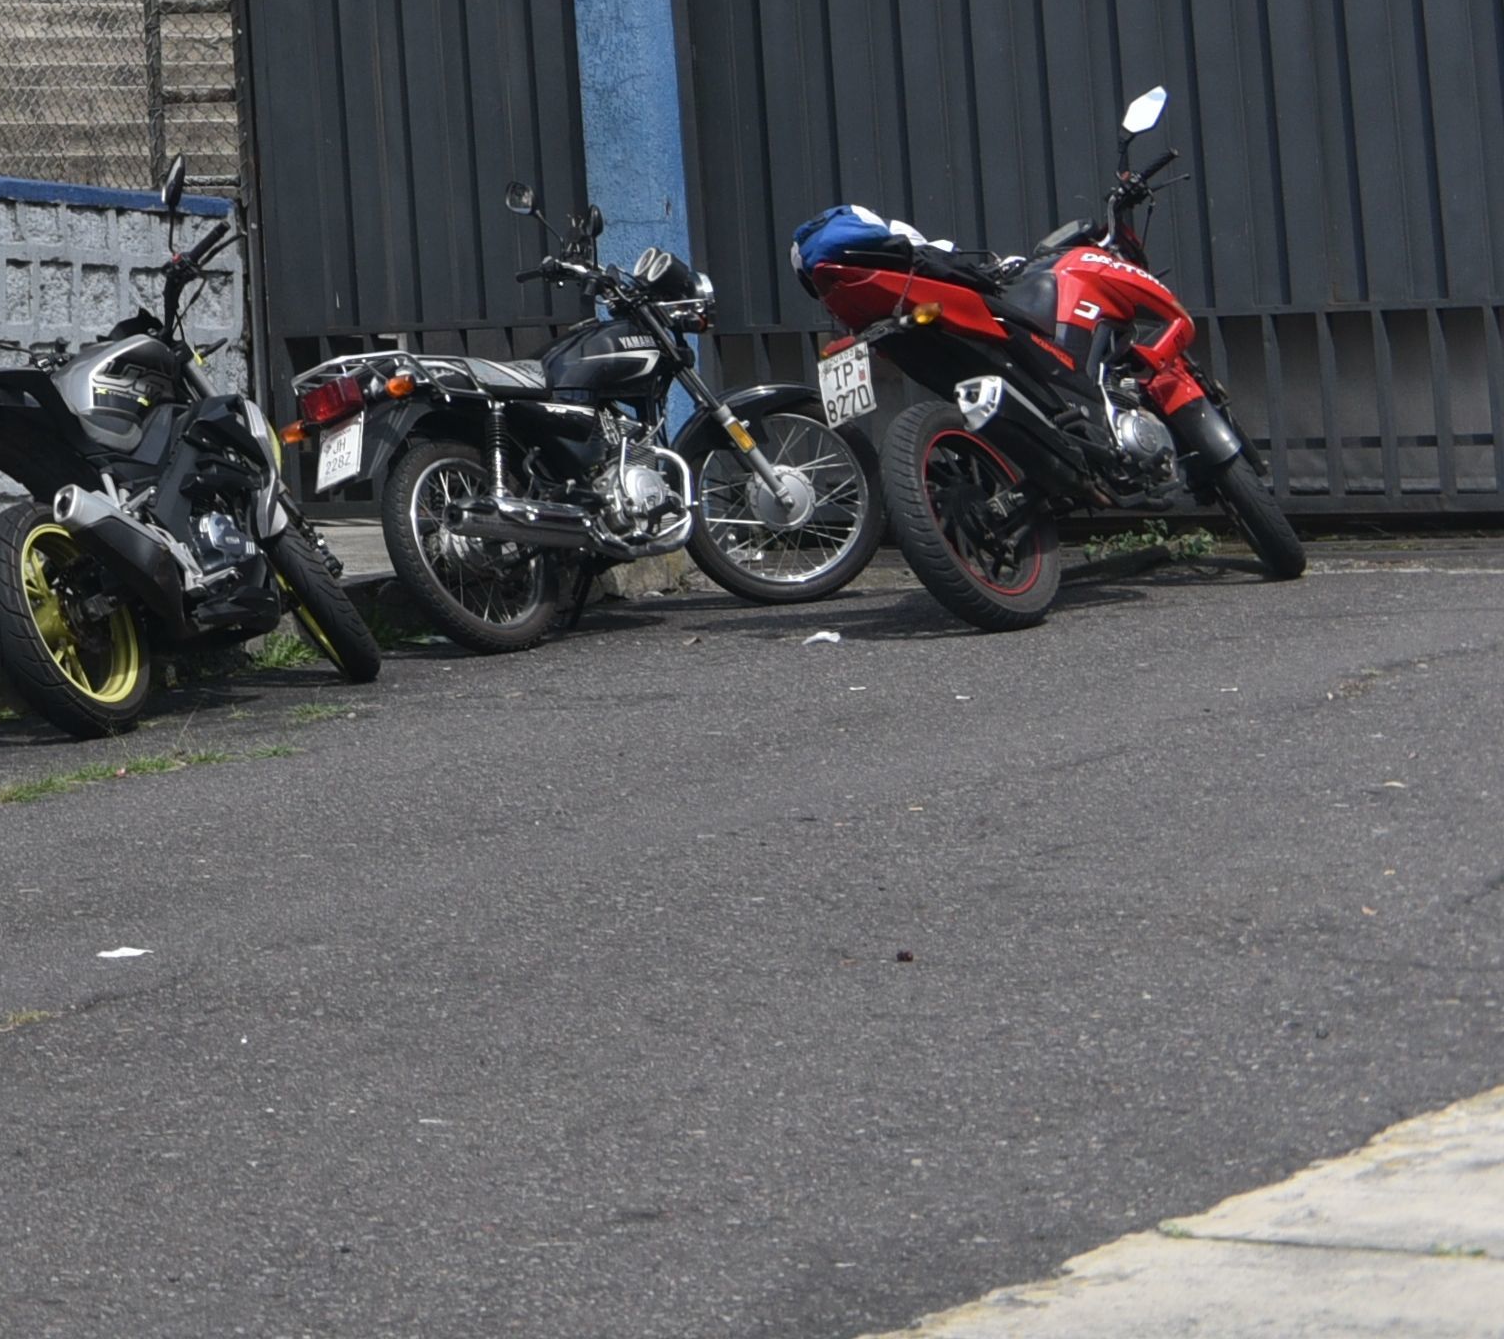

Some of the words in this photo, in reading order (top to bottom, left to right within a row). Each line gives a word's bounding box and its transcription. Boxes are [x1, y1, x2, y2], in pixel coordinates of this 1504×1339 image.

[618, 335, 657, 350] YAMAHA
[833, 361, 854, 391] IP
[826, 384, 871, 423] 827D
